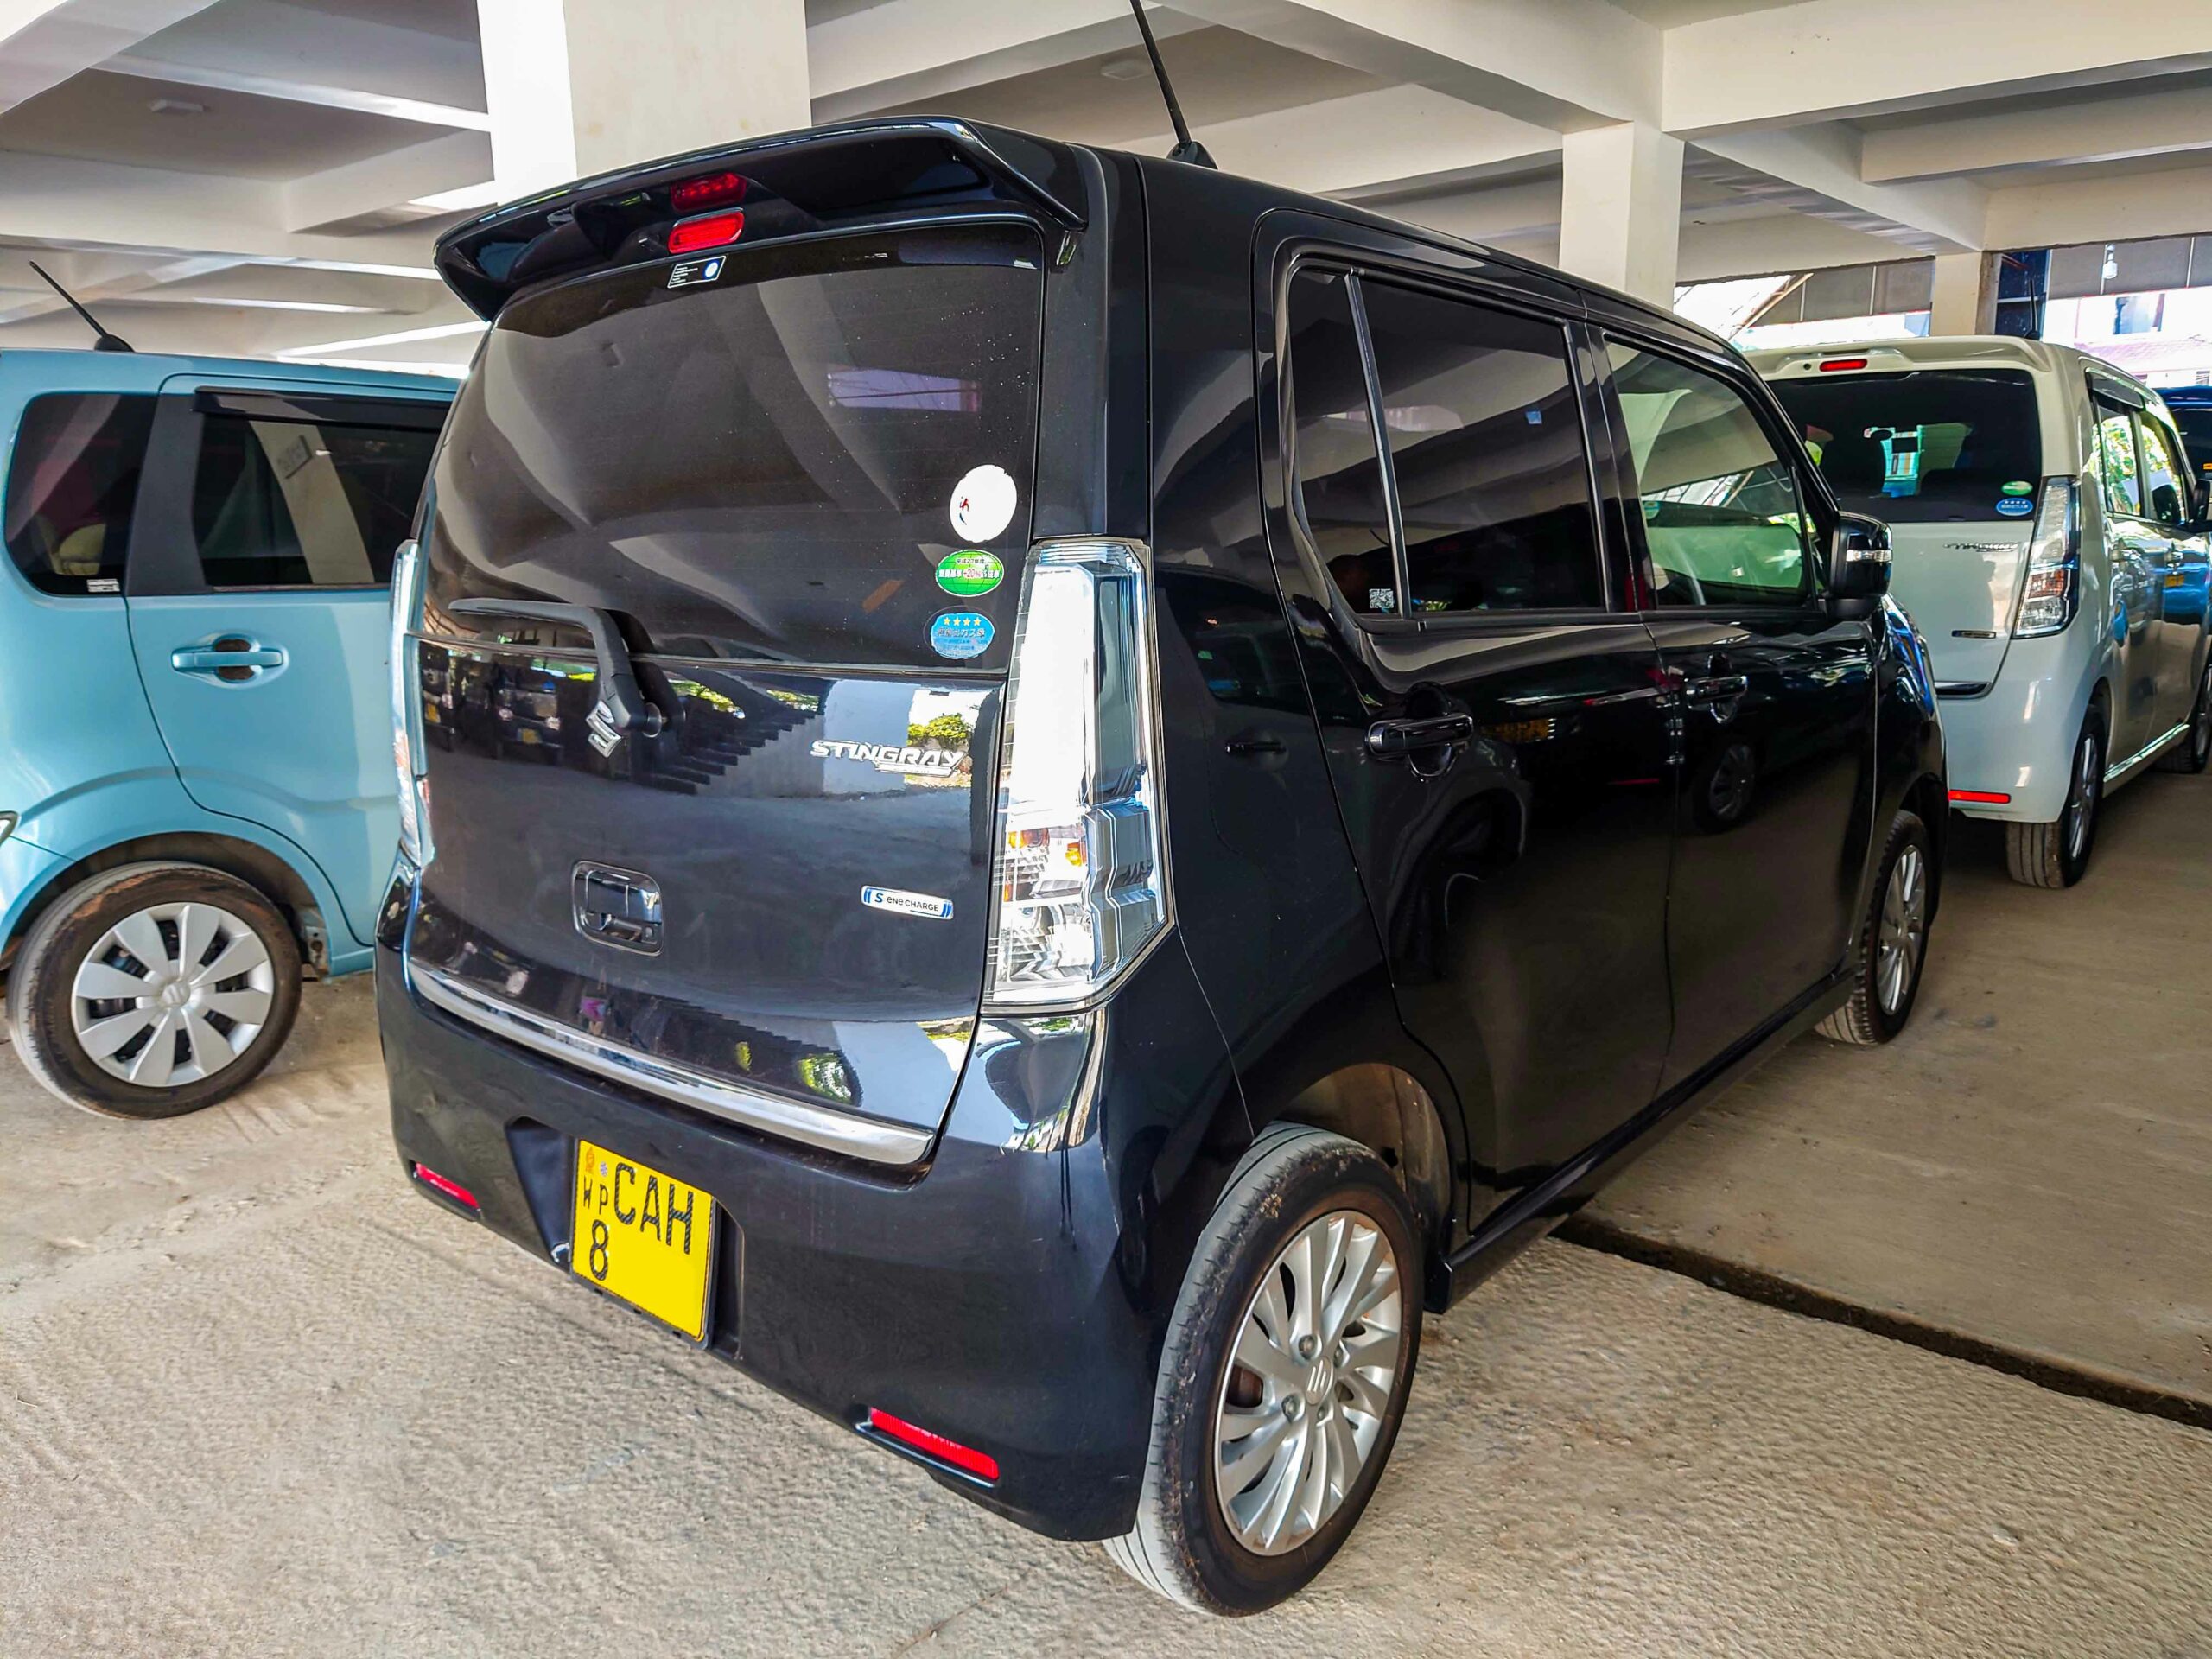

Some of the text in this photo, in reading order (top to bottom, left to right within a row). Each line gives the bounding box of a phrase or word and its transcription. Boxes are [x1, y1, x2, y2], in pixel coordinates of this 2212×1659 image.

[810, 740, 965, 767] STINGRAY
[905, 899, 939, 912] CHARGE
[614, 1161, 694, 1255] CAH
[589, 1219, 609, 1281] 8
